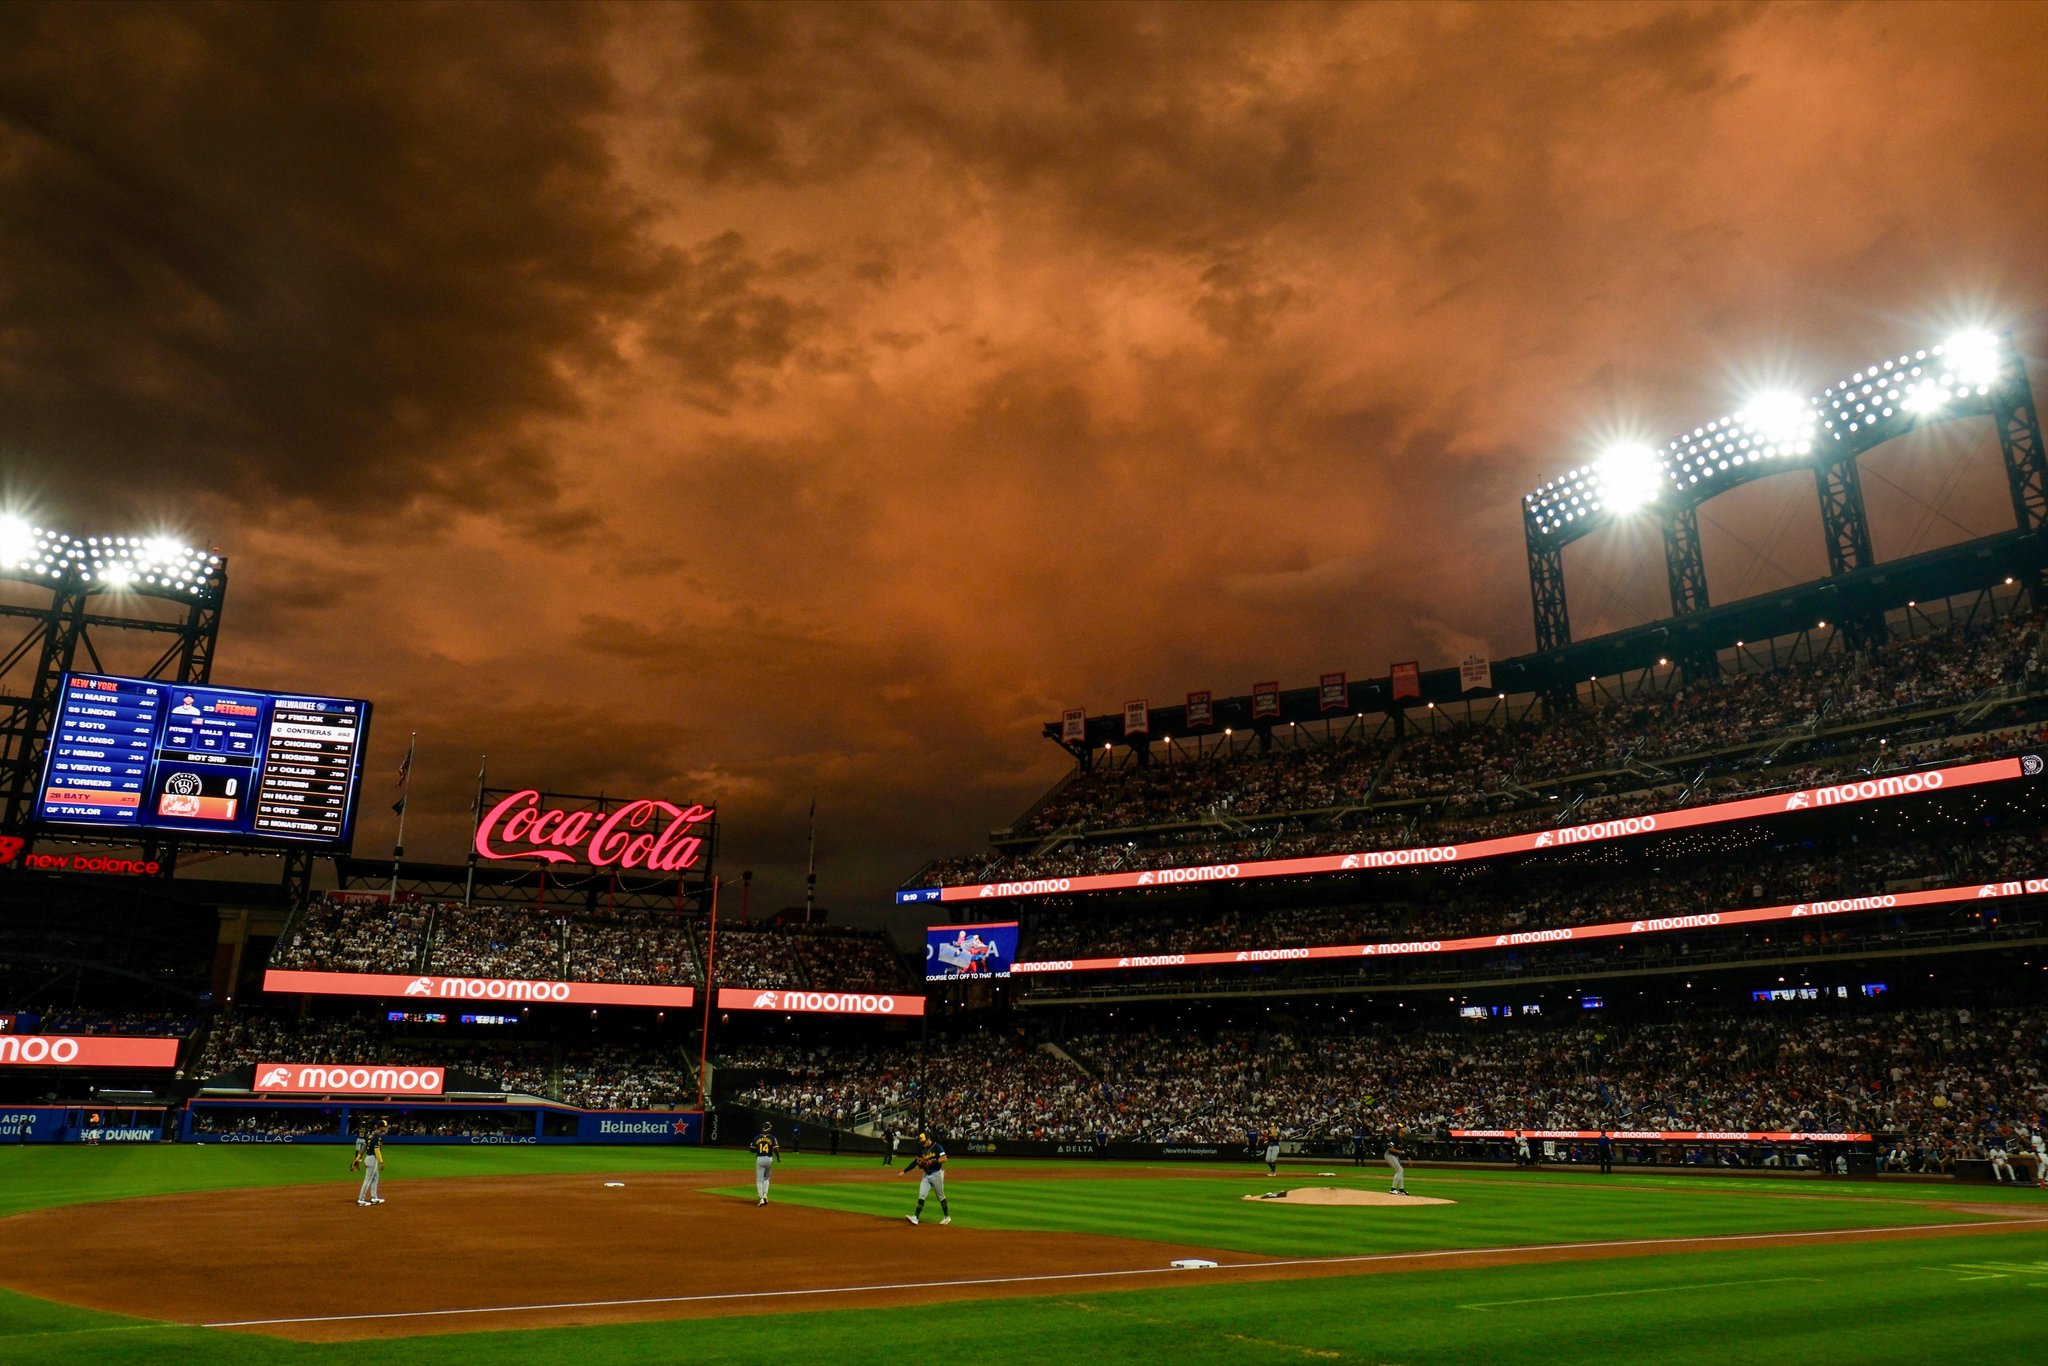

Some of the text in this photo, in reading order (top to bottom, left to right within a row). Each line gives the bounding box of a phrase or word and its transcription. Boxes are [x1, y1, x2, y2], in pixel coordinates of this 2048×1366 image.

[70, 678, 89, 688] NEW
[97, 681, 118, 691] YORK
[84, 693, 118, 703] MARTE
[214, 703, 257, 716] PETERSON
[275, 700, 316, 710] MILWAUKEE
[81, 708, 116, 717] LINDOR
[79, 721, 105, 730] SOTO
[287, 728, 332, 736] CONTRERAS
[76, 736, 114, 744] ALONSO
[284, 740, 322, 749] CHOURIO
[73, 750, 105, 758] NIMMO
[282, 754, 319, 762] HOSKINS
[70, 764, 111, 773] VIENTOS
[280, 767, 316, 775] COLLINS
[67, 778, 112, 787] TORRENS
[225, 778, 238, 796] 0
[277, 780, 309, 788] DURBIN
[1816, 771, 1942, 805] moomoo
[275, 793, 305, 802] HAASE
[61, 807, 101, 815] TAYLOR
[226, 800, 234, 818] 1
[273, 807, 299, 815] ORTIZ
[270, 820, 318, 830] MONASTERIO
[1559, 816, 1655, 843] moomoo
[475, 789, 715, 872] Coca-Cola
[1365, 847, 1456, 866] moomoo
[25, 853, 159, 874] new balance
[1158, 865, 1239, 883] moomoo
[998, 879, 1069, 895] moomoo
[1812, 895, 1895, 914] moomoo
[1649, 914, 1719, 930] moomoo
[1511, 929, 1572, 944] moomoo
[1379, 942, 1440, 953] moomoo
[1251, 949, 1308, 960] moomoo
[1132, 955, 1184, 966] moomoo
[1024, 961, 1072, 971] moomoo
[441, 978, 569, 1000] moomoo
[784, 992, 893, 1012] moomoo
[299, 1068, 439, 1089] moomoo
[600, 1120, 668, 1134] Heineken
[105, 1130, 154, 1140] DUNKIN'
[220, 1134, 293, 1143] CADILLAC
[470, 1136, 537, 1144] CADILLAC
[759, 1143, 769, 1153] 14
